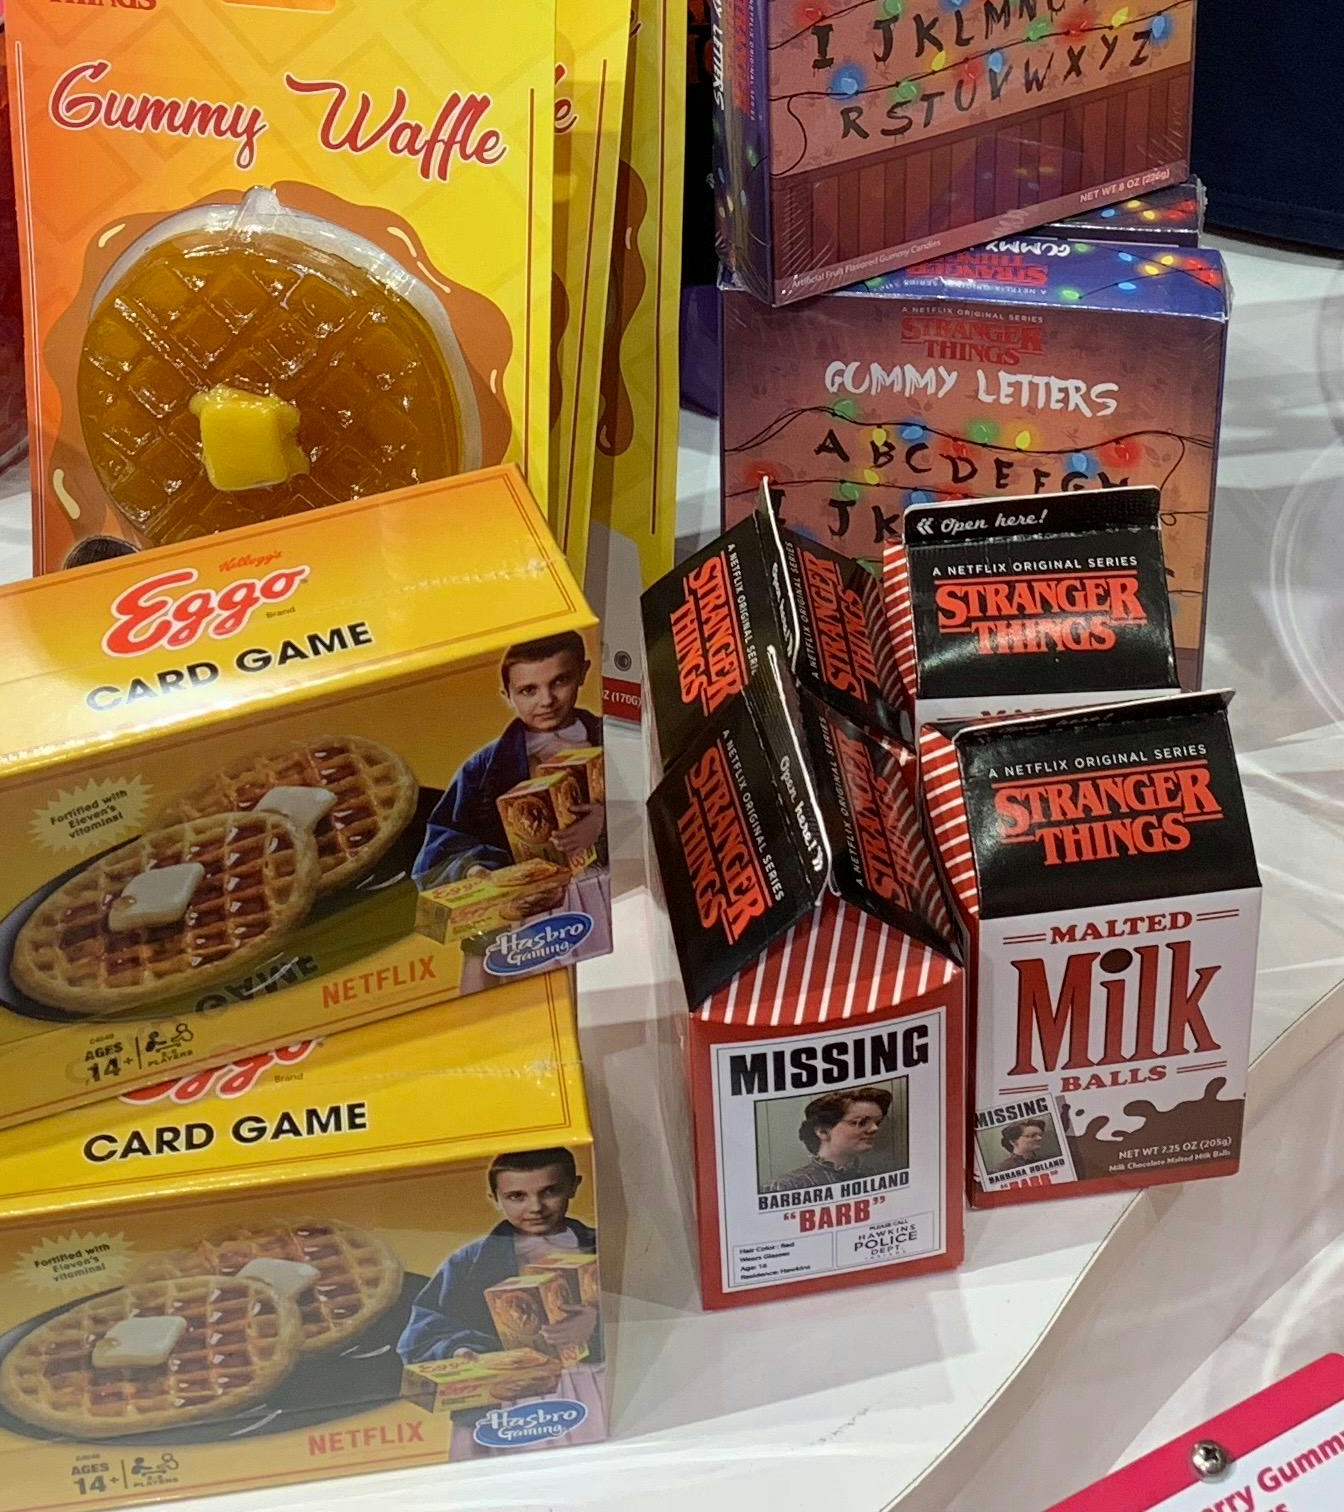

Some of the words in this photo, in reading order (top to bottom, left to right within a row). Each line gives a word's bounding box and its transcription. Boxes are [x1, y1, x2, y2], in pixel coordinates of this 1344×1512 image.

[49, 58, 266, 171] Gummy
[284, 72, 507, 182] Waffle
[1080, 190, 1100, 203] NET
[1101, 184, 1117, 197] WT
[1126, 176, 1140, 190] OZ
[900, 315, 1044, 355] STRANGER
[925, 339, 1021, 366] THINGS
[825, 360, 957, 399] GUMMY
[976, 369, 1120, 418] LETTERS
[940, 516, 988, 536] Open
[995, 509, 1048, 528] here!
[932, 567, 941, 576] A
[947, 562, 1007, 575] NETFLIX
[1012, 559, 1082, 572] ORIGINAL
[1087, 556, 1138, 568] SERIES
[103, 564, 310, 659] Eggo
[934, 577, 1147, 628] STRANGER
[970, 616, 1117, 655] THINGS
[85, 660, 219, 713] CARD
[235, 622, 373, 673] GAME
[988, 768, 997, 778] A
[1005, 759, 1068, 777] NETFLIX
[1074, 751, 1148, 769] ORIGINAL
[1154, 744, 1207, 759] SERIES
[50, 800, 99, 826] Fortified
[101, 790, 128, 805] with
[68, 805, 116, 828] Eleven's
[994, 767, 1222, 837] STRANGER
[1035, 814, 1190, 866] THINGS
[499, 919, 584, 955] Hasbro
[1049, 910, 1193, 945] MALTED
[506, 939, 570, 966] Gaming
[322, 956, 437, 1008] NETFLIX
[1006, 941, 1223, 1077] Milk
[730, 1024, 929, 1096] MISSING
[1060, 1065, 1168, 1092] BALLS
[976, 1097, 1048, 1128] MISSING
[82, 1123, 215, 1164] CARD
[232, 1103, 369, 1145] GAME
[1118, 1148, 1140, 1160] NET
[1142, 1147, 1158, 1156] WT
[1182, 1141, 1197, 1151] OZ
[758, 1186, 834, 1210] BARBARA
[840, 1171, 910, 1198] HOLLAND
[854, 1231, 918, 1252] POLICE
[858, 1224, 916, 1241] HAWKINS
[307, 1421, 425, 1457] NETFLIX
